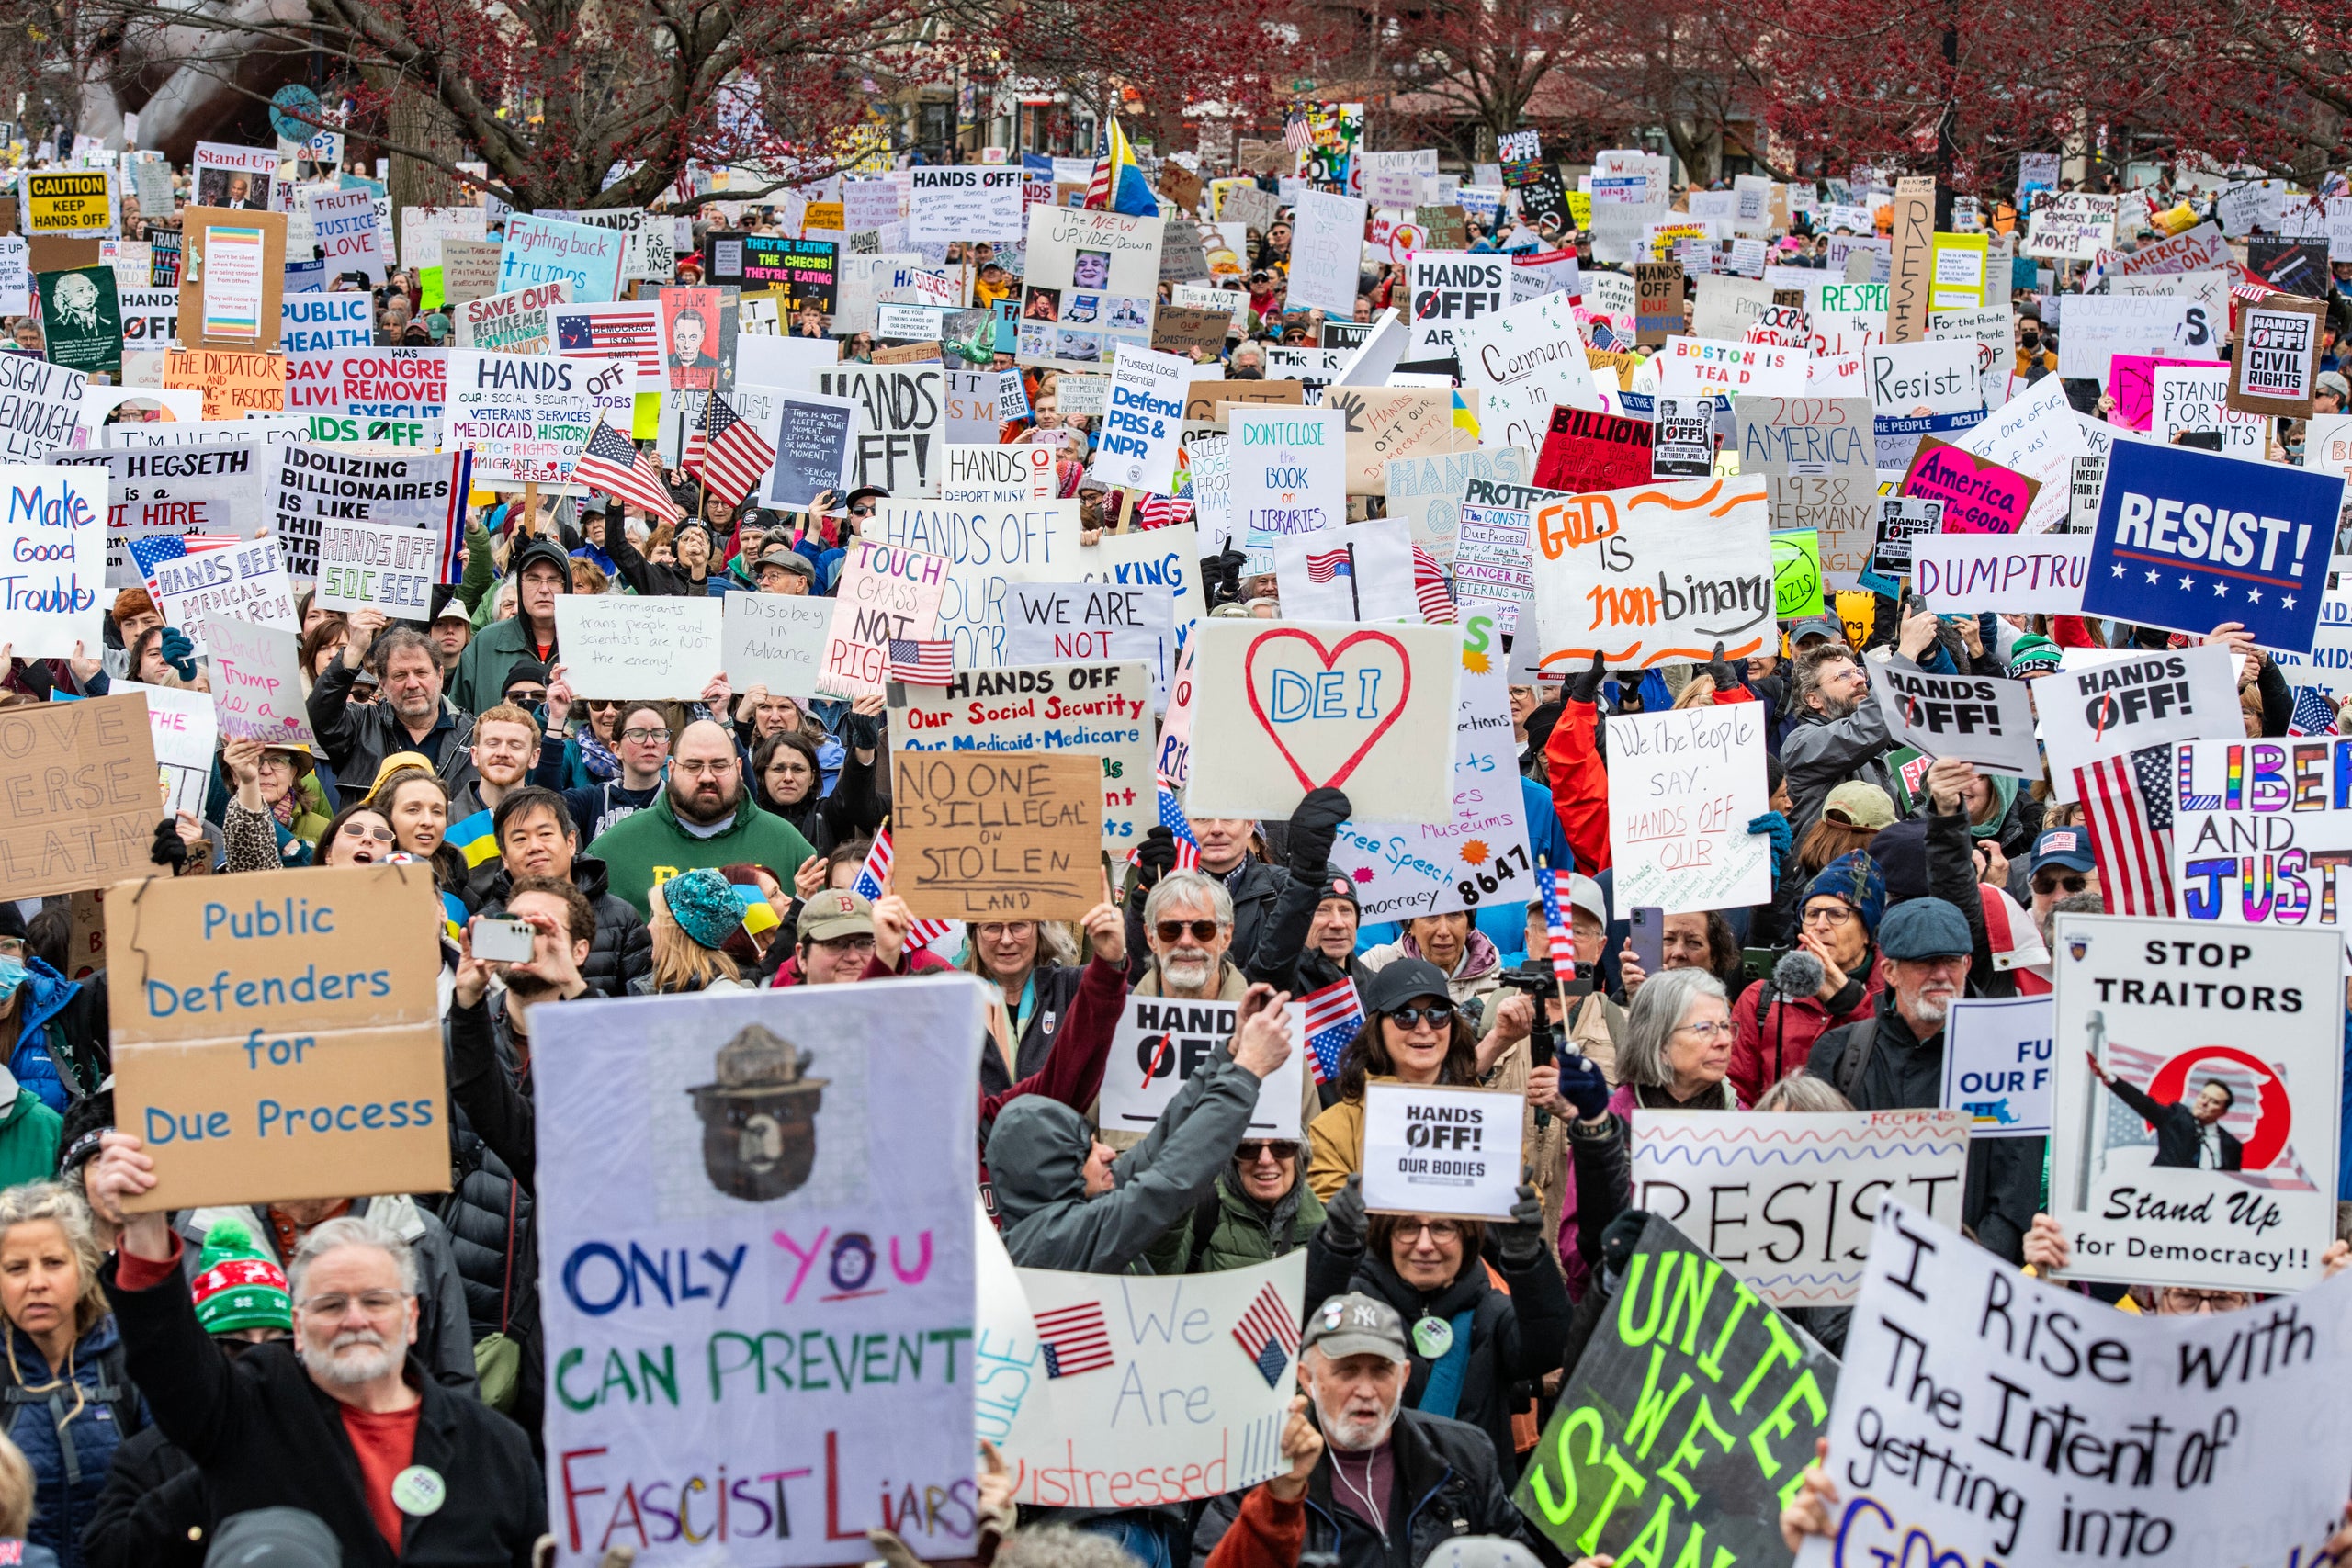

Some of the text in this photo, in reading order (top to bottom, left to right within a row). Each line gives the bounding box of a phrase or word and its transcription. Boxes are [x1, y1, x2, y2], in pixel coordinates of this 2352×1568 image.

[1497, 129, 1538, 145] HANDS
[1498, 141, 1542, 162] OFF!
[198, 150, 276, 171] Stand Up
[31, 175, 106, 196] CAUTION
[913, 171, 1021, 187] HANDS OFF!
[53, 200, 85, 213] KEEP
[315, 193, 368, 209] TRUTH
[34, 213, 106, 227] HANDS OFF
[315, 213, 375, 236] JUSTICE
[1061, 209, 1137, 232] The NEW
[323, 234, 374, 257] LOVE
[507, 220, 609, 257] Fighting back
[745, 238, 833, 254] THEY'RE EATING
[759, 254, 832, 270] THE CHECKS!
[1418, 265, 1502, 288] HANDS
[1636, 264, 1682, 280] HANDS
[469, 283, 566, 323] SAVE OUR
[1641, 281, 1672, 297] OFF
[1642, 299, 1669, 314] DUE
[592, 321, 654, 333] DEMOCRACY
[2252, 328, 2304, 349] OFF!
[2254, 317, 2307, 332] HANDS
[1481, 338, 1572, 384] Conman
[1676, 341, 1786, 368] BOSTON IS
[2251, 351, 2302, 373] CIVIL
[1, 355, 85, 400] SIGN IS
[477, 363, 625, 396] HANDS OFF
[2248, 371, 2301, 389] RIGHTS
[1113, 386, 1183, 419] Defend
[1771, 397, 1847, 426] 2025
[1108, 410, 1166, 439] PBS &
[1243, 422, 1324, 446] DON'T CLOSE
[1666, 417, 1702, 426] HANDS
[1666, 425, 1702, 444] OFF!
[1103, 433, 1148, 459] NPR
[1747, 421, 1868, 466] AMERICA
[127, 450, 249, 477] HEGSETH
[284, 446, 408, 478] IDOLIZING
[950, 449, 1026, 483] HANDS
[1266, 467, 1309, 489] BOOK
[280, 468, 448, 500] BILLIONAIRES
[1775, 477, 1848, 506] 1938
[1917, 452, 2016, 514] America
[8, 479, 96, 530] Make
[142, 502, 209, 525] HIRE
[887, 509, 1059, 564] HANDS OFF
[1250, 507, 1328, 535] LIBRARIES
[2114, 491, 2312, 577] RESIST!
[13, 533, 75, 562] Good
[323, 527, 435, 569] HANDS OFF
[858, 541, 943, 586] TOUCH
[159, 541, 286, 595] HANDS OFF!
[0, 572, 96, 614] Trouble
[1019, 592, 1145, 626] WE ARE
[1587, 570, 1772, 631] non-binary
[744, 599, 824, 629] Disobey
[744, 640, 811, 664] Advance
[1055, 631, 1113, 658] NOT
[217, 659, 280, 692] Trump
[946, 667, 1120, 700] HANDS OFF
[1885, 671, 1996, 702] HANDS
[2078, 656, 2186, 696] HANDS
[908, 694, 1145, 729] Our Social Security
[1894, 694, 2002, 737] OFF!
[2086, 681, 2192, 742] OFF!
[1044, 727, 1140, 749] Medicare
[1609, 706, 1754, 759] We the People
[899, 761, 1056, 802] NO ONE
[1422, 813, 1514, 840] Museums
[1627, 795, 1734, 840] HANDS OFF
[979, 829, 1002, 844] ON
[2191, 815, 2295, 854] AND
[922, 845, 1069, 881] STOLEN
[1389, 837, 1454, 888] Speech
[1661, 840, 1713, 870] OUR
[1457, 844, 1531, 905] 8647
[966, 890, 1030, 911] LAND
[204, 897, 334, 941] Public
[2145, 940, 2252, 968] STOP
[146, 964, 391, 1018] Defenders
[2094, 977, 2303, 1012] TRAITORS
[243, 1029, 316, 1070] for
[144, 1099, 434, 1145] Due Process
[1407, 1106, 1483, 1123] HANDS
[1406, 1122, 1482, 1155] OFF!
[1398, 1157, 1486, 1177] OUR BODIES
[2102, 1186, 2281, 1235] Stand Up
[2075, 1232, 2309, 1272] for Democracy!!
[562, 1225, 934, 1316] ONLY YOU
[1121, 1277, 1214, 1344] We
[2179, 1305, 2315, 1389] with
[556, 1327, 974, 1413] CAN PREVENT
[1111, 1359, 1216, 1427] Are
[1880, 1315, 2240, 1490] The Intent of
[1623, 1344, 1736, 1510] WE
[1848, 1407, 2174, 1558] getting into
